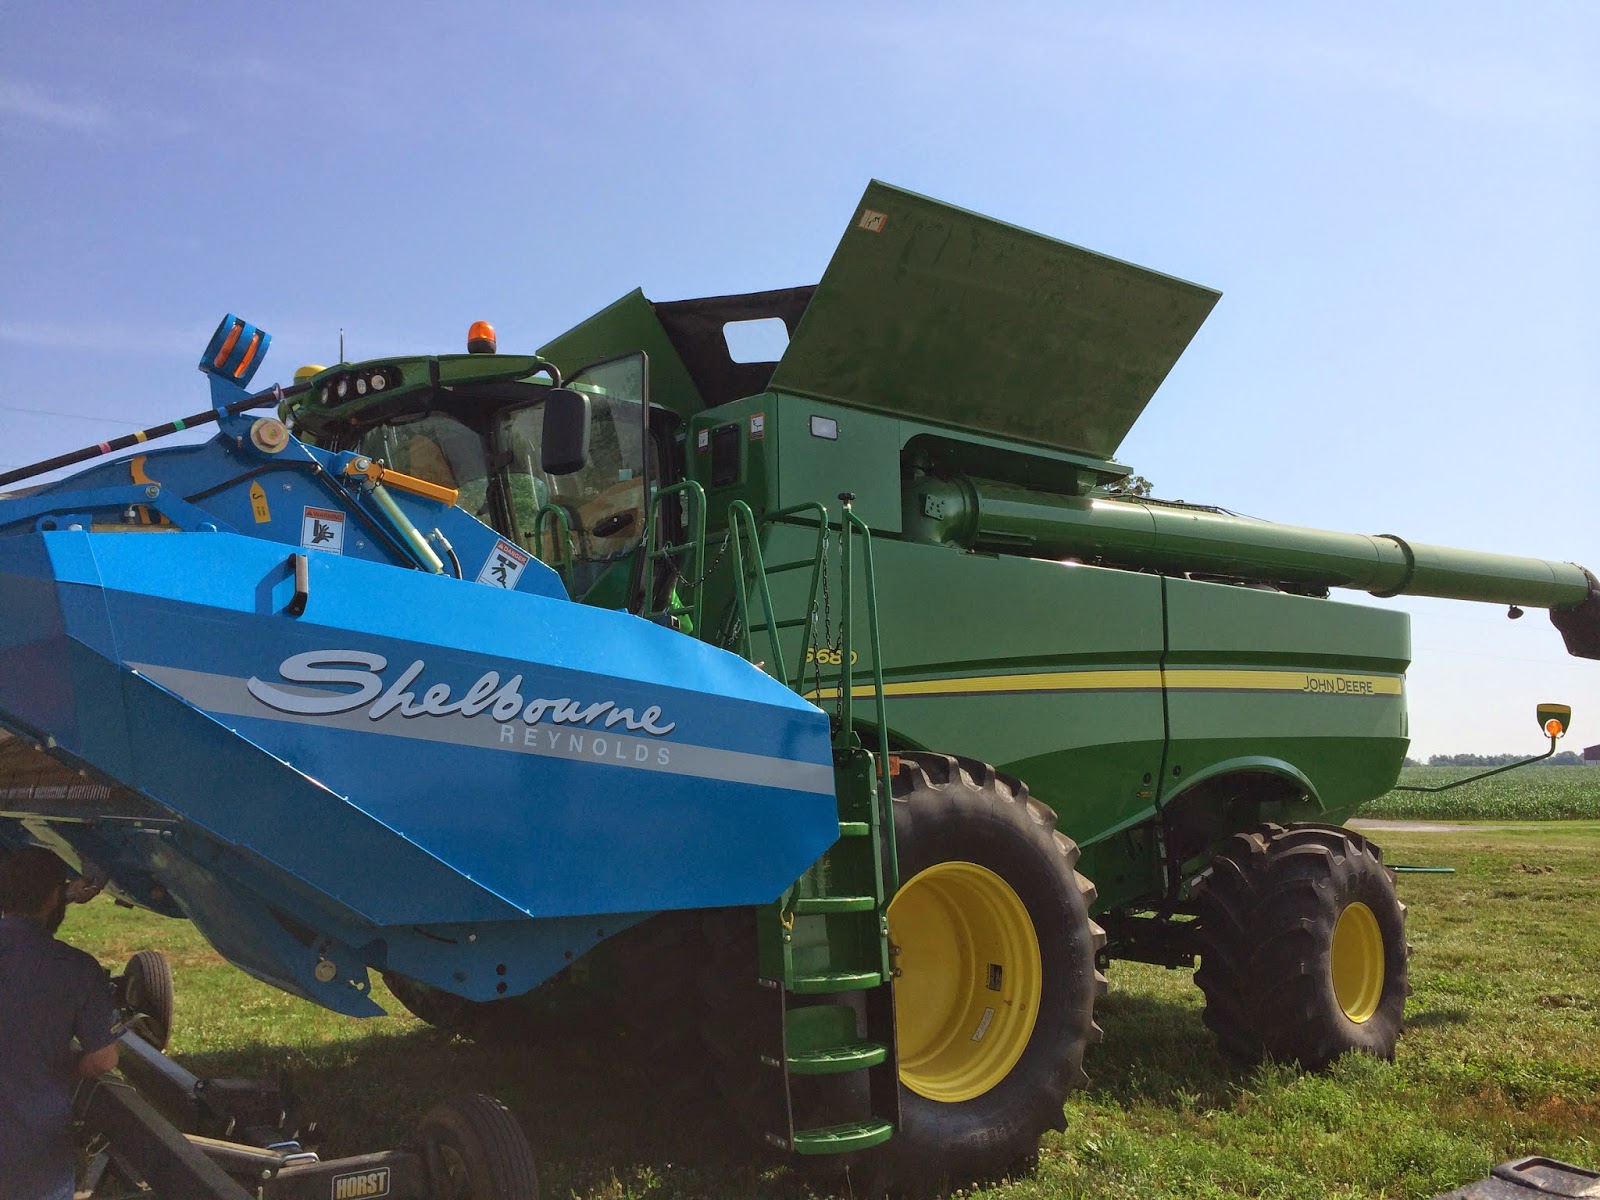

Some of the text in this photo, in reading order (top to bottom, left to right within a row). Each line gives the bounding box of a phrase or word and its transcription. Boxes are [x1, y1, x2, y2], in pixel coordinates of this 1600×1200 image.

[313, 510, 343, 521] WARNING
[503, 547, 527, 563] DANGER
[247, 649, 676, 736] Shelbourne
[1303, 675, 1374, 693] JOHN DEERE
[500, 724, 670, 765] REYNOLDS
[336, 1172, 387, 1199] HORST
